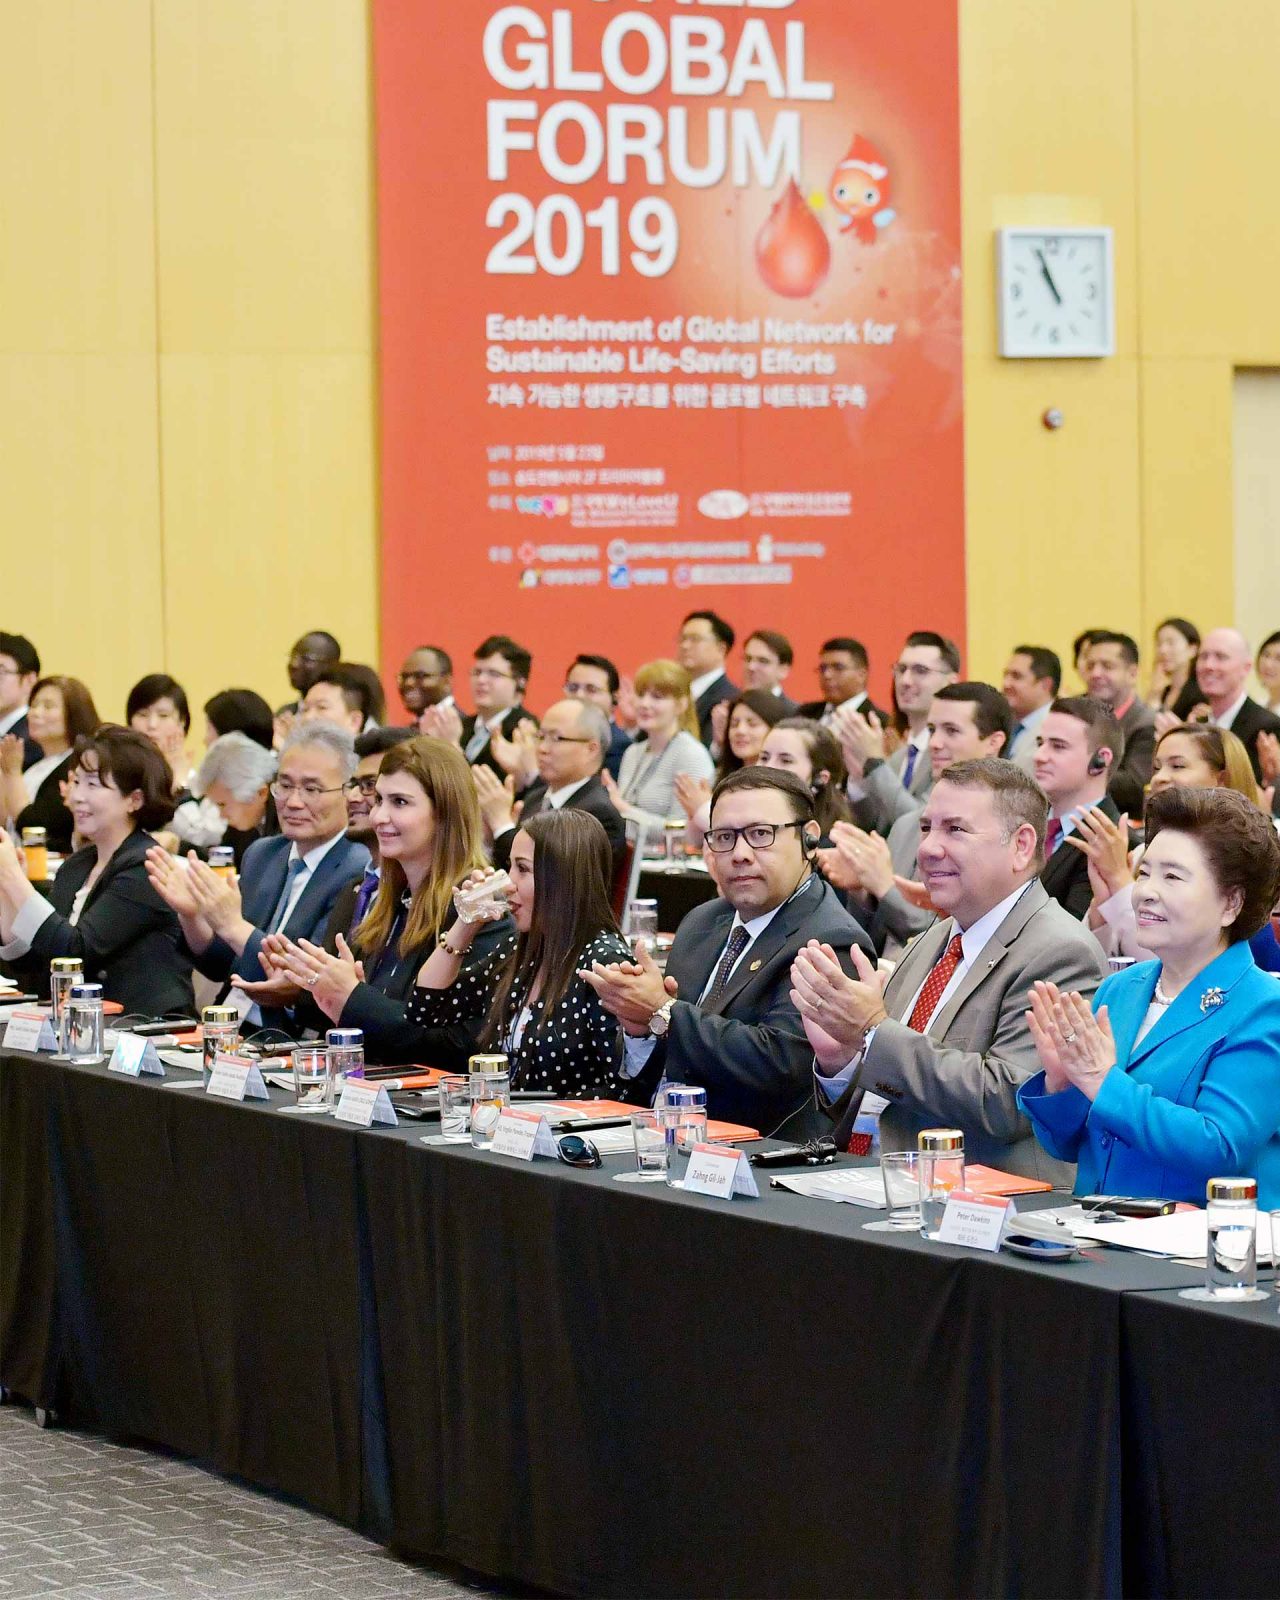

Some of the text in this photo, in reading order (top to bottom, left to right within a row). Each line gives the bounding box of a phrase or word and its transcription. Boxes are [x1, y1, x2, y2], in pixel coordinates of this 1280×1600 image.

[482, 6, 834, 102] GLOBAL
[486, 98, 802, 190] FORUM
[485, 193, 679, 277] 2019
[486, 313, 897, 344] Establishment of Global Network for
[486, 346, 837, 379] Sustainable Life-Saving Efforts
